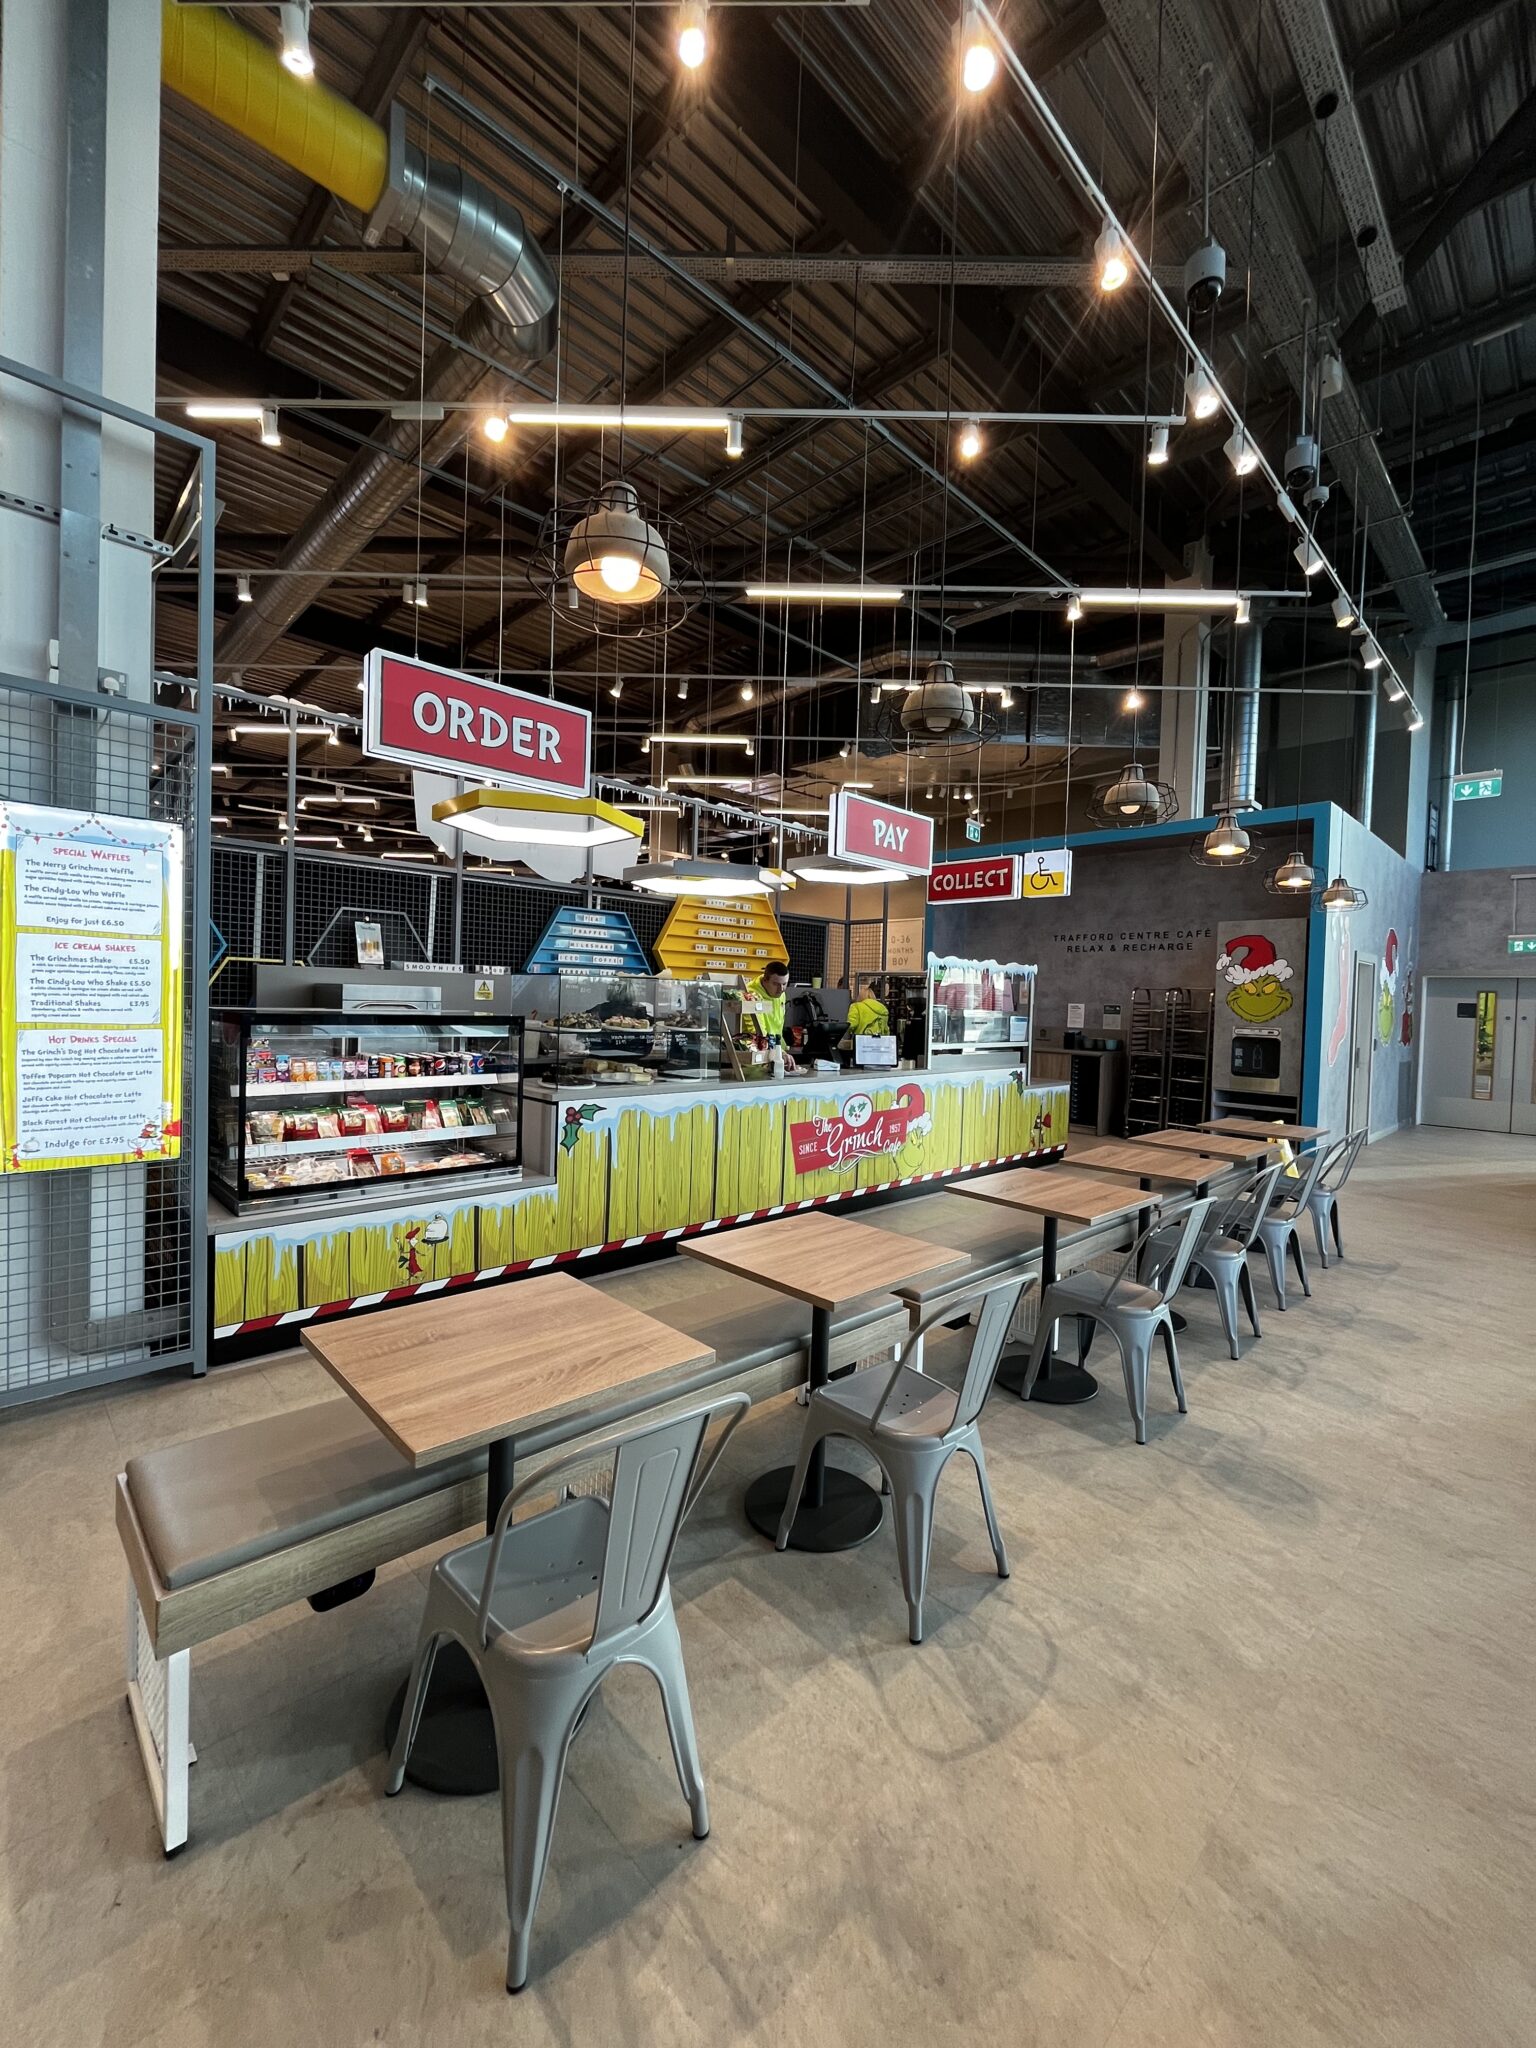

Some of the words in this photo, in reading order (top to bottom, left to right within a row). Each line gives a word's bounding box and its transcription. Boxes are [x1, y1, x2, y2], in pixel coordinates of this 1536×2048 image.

[412, 690, 562, 764] ORDER
[872, 818, 910, 853] PAY
[53, 847, 87, 858] SPECIAL
[91, 849, 131, 862] WAFFLES
[25, 858, 41, 866] The
[43, 860, 67, 870] Merry
[68, 862, 108, 873] Grinchmas
[110, 866, 134, 875] Waffle
[932, 867, 1009, 892] COLLECT
[24, 884, 40, 892] The
[42, 885, 81, 895] Cindy-Lou
[82, 888, 99, 897] Who
[101, 890, 126, 899] Waffle
[46, 916, 69, 925] Enjoy
[71, 917, 83, 925] for
[84, 917, 99, 926] just
[101, 919, 125, 927] £6.50
[1053, 933, 1114, 942] TRAFFORD
[1120, 931, 1169, 940] CENTRE
[1176, 928, 1212, 938] CAFÉ
[54, 942, 69, 950] ICE
[72, 942, 101, 951] CREAM
[105, 944, 136, 953] SHAKES
[1066, 944, 1104, 953] RELAX
[1109, 944, 1116, 952] &
[1123, 942, 1194, 951] RECHARGE
[30, 953, 45, 961] The
[47, 954, 88, 963] Grinchmas
[89, 956, 112, 964] Shake
[892, 957, 909, 966] BOY
[405, 963, 462, 972] SMOOTHIES
[29, 977, 45, 985] The
[47, 978, 86, 987] Cindy-Lou
[87, 978, 104, 986] Who
[74, 999, 101, 1007] Shakes
[48, 1035, 66, 1044] HOT
[70, 1035, 99, 1044] DRINKS
[102, 1035, 137, 1043] SPECIALS
[38, 1047, 66, 1055] Grinch's
[68, 1048, 82, 1056] Dog
[22, 1072, 46, 1080] Toffee
[48, 1072, 76, 1080] Popcorn
[79, 1092, 113, 1100] Chocolate
[45, 1118, 67, 1126] Forest
[812, 1115, 833, 1136] The
[888, 1123, 901, 1134] 1957
[45, 1139, 80, 1149] Indulge
[82, 1138, 97, 1146] for
[99, 1136, 125, 1145] £3.95
[821, 1116, 884, 1171] Grinch
[882, 1137, 903, 1156] Cafe
[798, 1141, 818, 1156] SINCE
